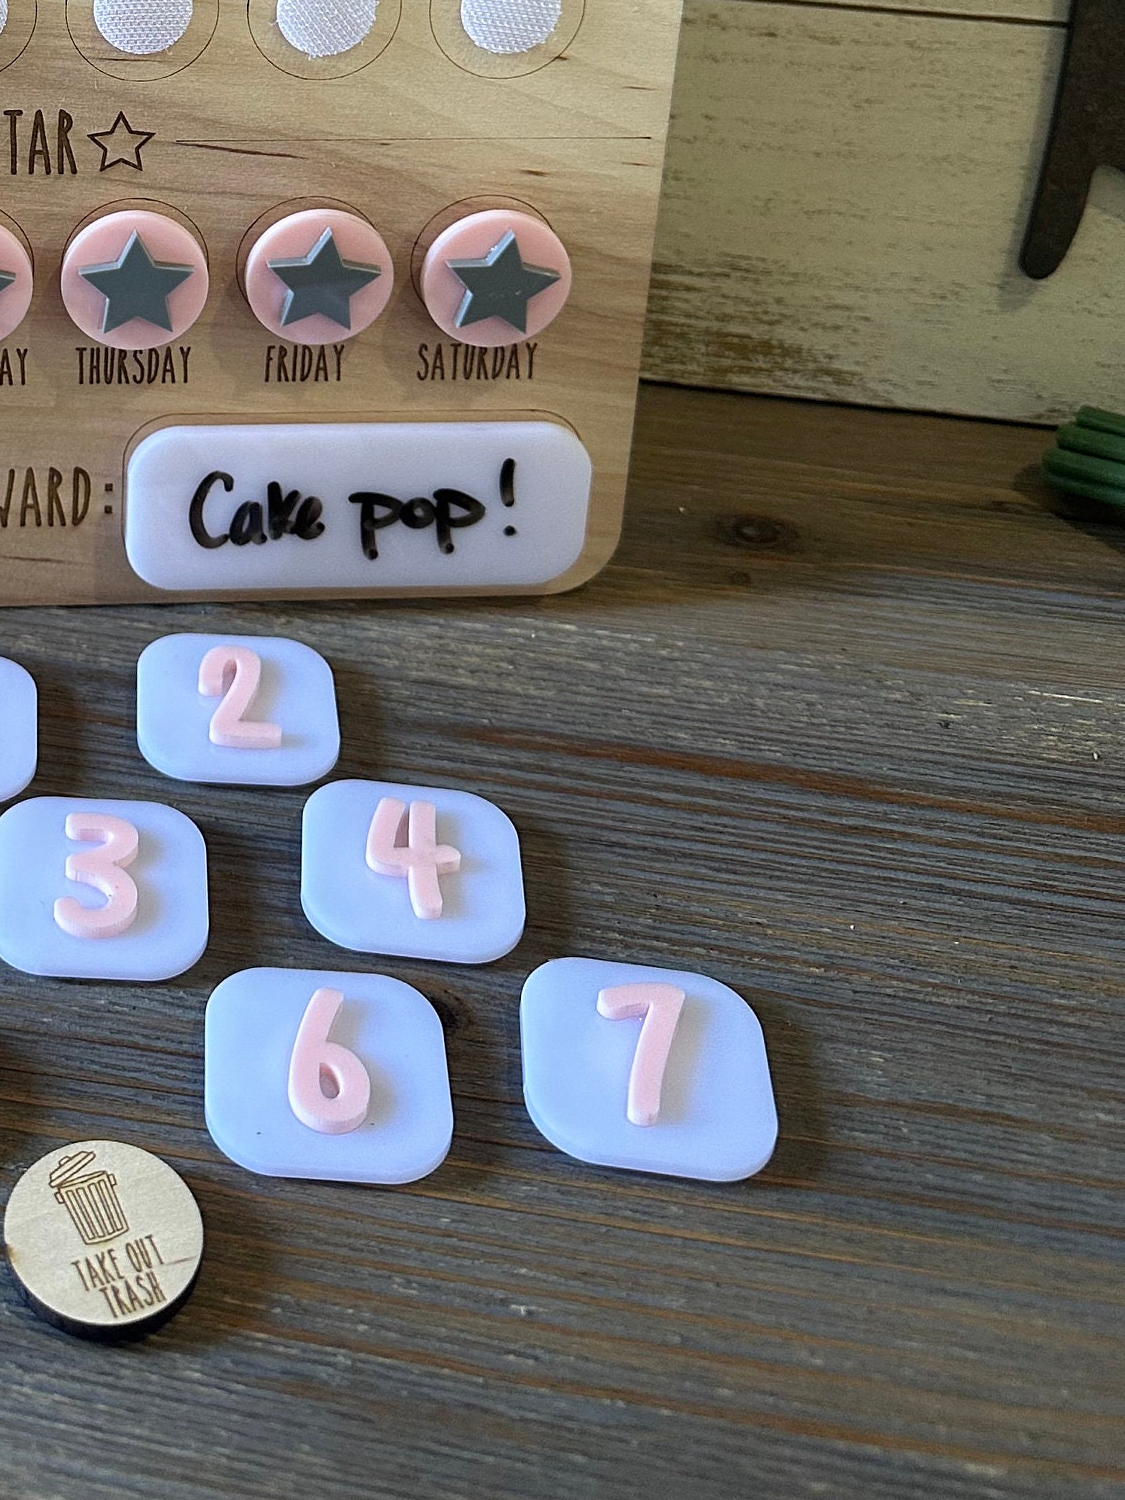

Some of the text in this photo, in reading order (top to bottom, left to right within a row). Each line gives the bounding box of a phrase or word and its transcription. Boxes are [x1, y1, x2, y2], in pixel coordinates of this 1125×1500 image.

[75, 346, 191, 385] THURSDAY
[264, 344, 345, 382] FRIDAY
[416, 342, 538, 381] SATURDAY
[187, 457, 517, 561] Cake pop!
[197, 644, 283, 751] 2
[53, 811, 141, 940] 3
[365, 796, 462, 921] 4
[287, 987, 370, 1134] 6
[596, 981, 687, 1128] 7
[70, 1234, 166, 1295] TAKE OUT
[98, 1276, 167, 1320] TRASH
